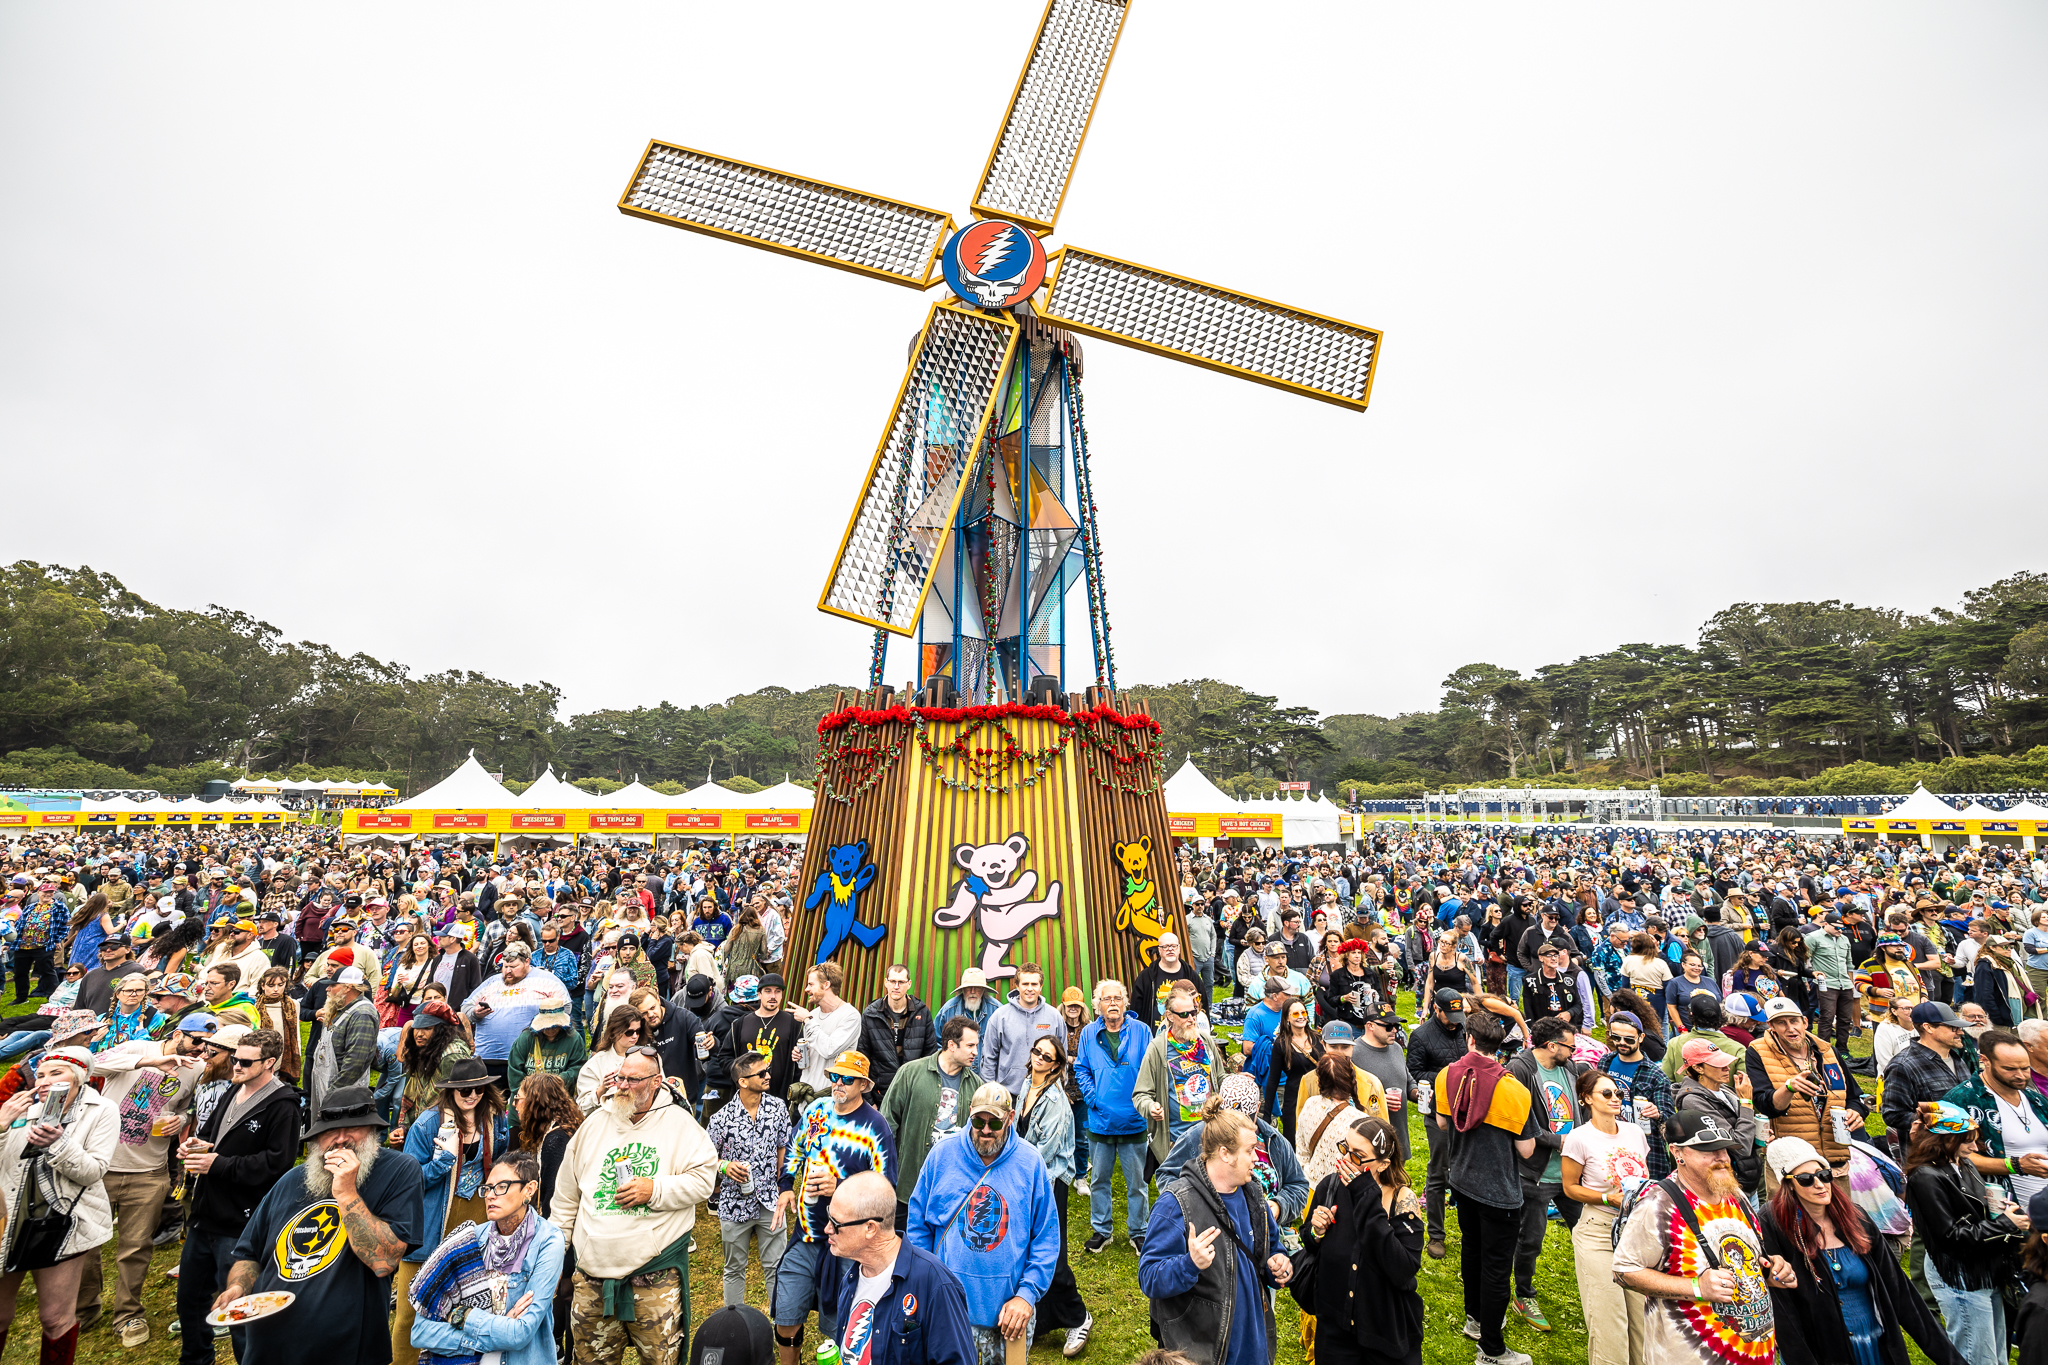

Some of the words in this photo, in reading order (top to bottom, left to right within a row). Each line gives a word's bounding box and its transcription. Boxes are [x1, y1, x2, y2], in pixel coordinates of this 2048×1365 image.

[1620, 1074, 1633, 1083] AMER
[599, 1161, 657, 1180] Sngs
[294, 1226, 318, 1234] Pittsburgh
[1710, 1295, 1770, 1316] GRATEF
[1743, 1312, 1773, 1332] DEA
[1481, 1356, 1498, 1364] HOKA
